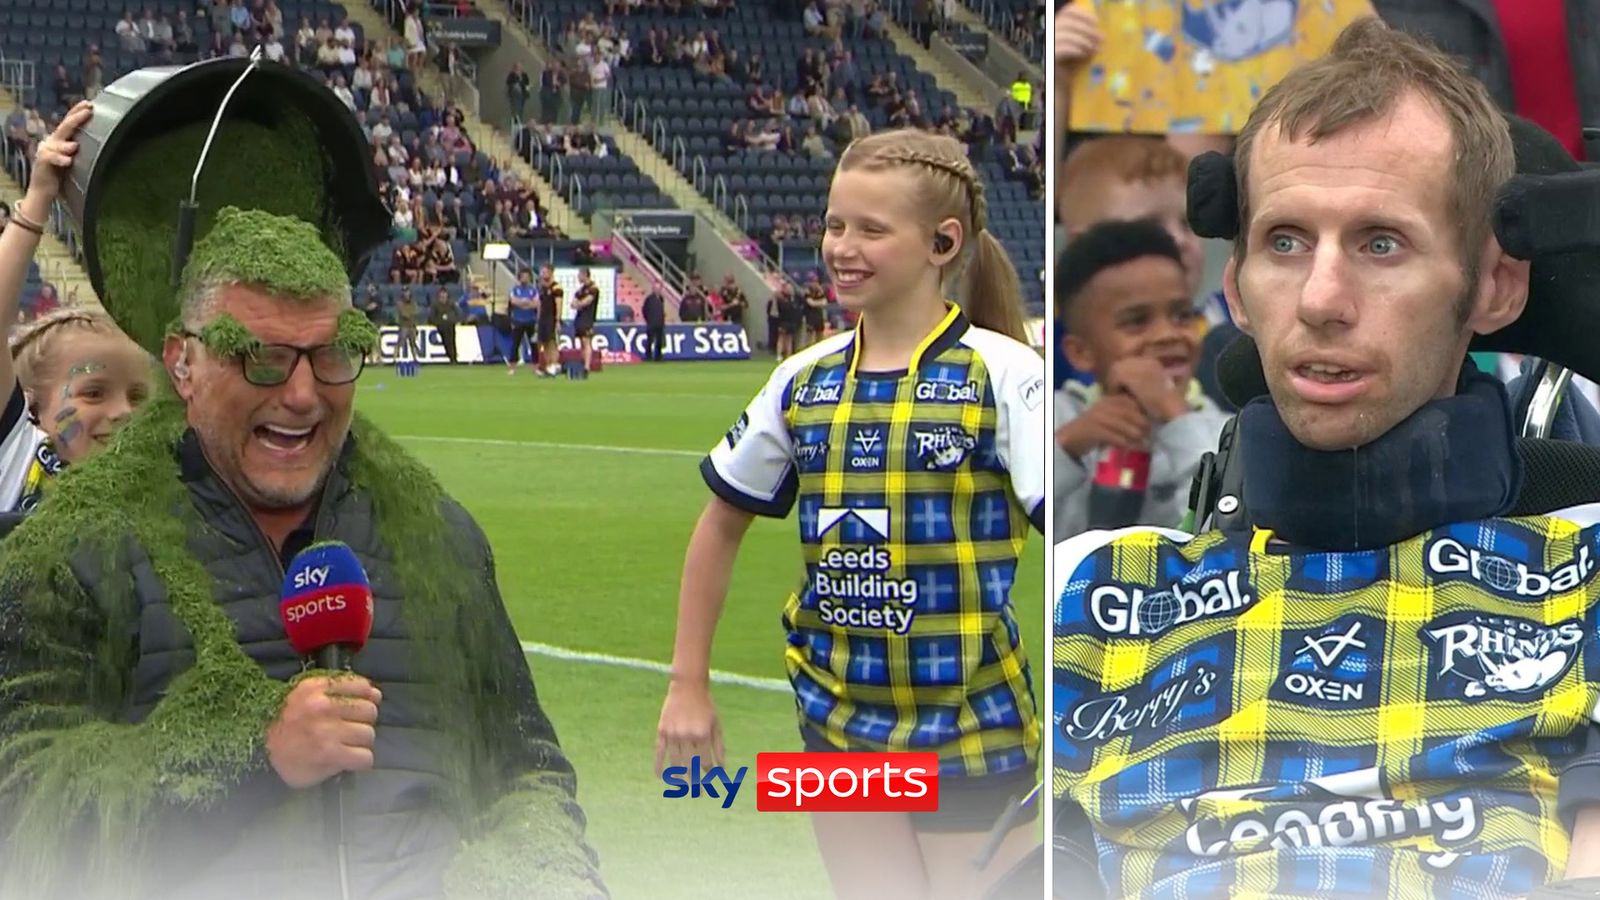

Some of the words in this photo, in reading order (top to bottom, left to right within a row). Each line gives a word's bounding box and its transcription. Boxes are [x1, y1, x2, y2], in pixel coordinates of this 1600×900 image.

[616, 328, 686, 354] Your
[294, 565, 330, 589] sky
[816, 572, 918, 604] Building
[286, 594, 347, 623] sports
[818, 600, 914, 633] Society
[1090, 570, 1251, 636] Global.
[1065, 667, 1217, 741] Berry's
